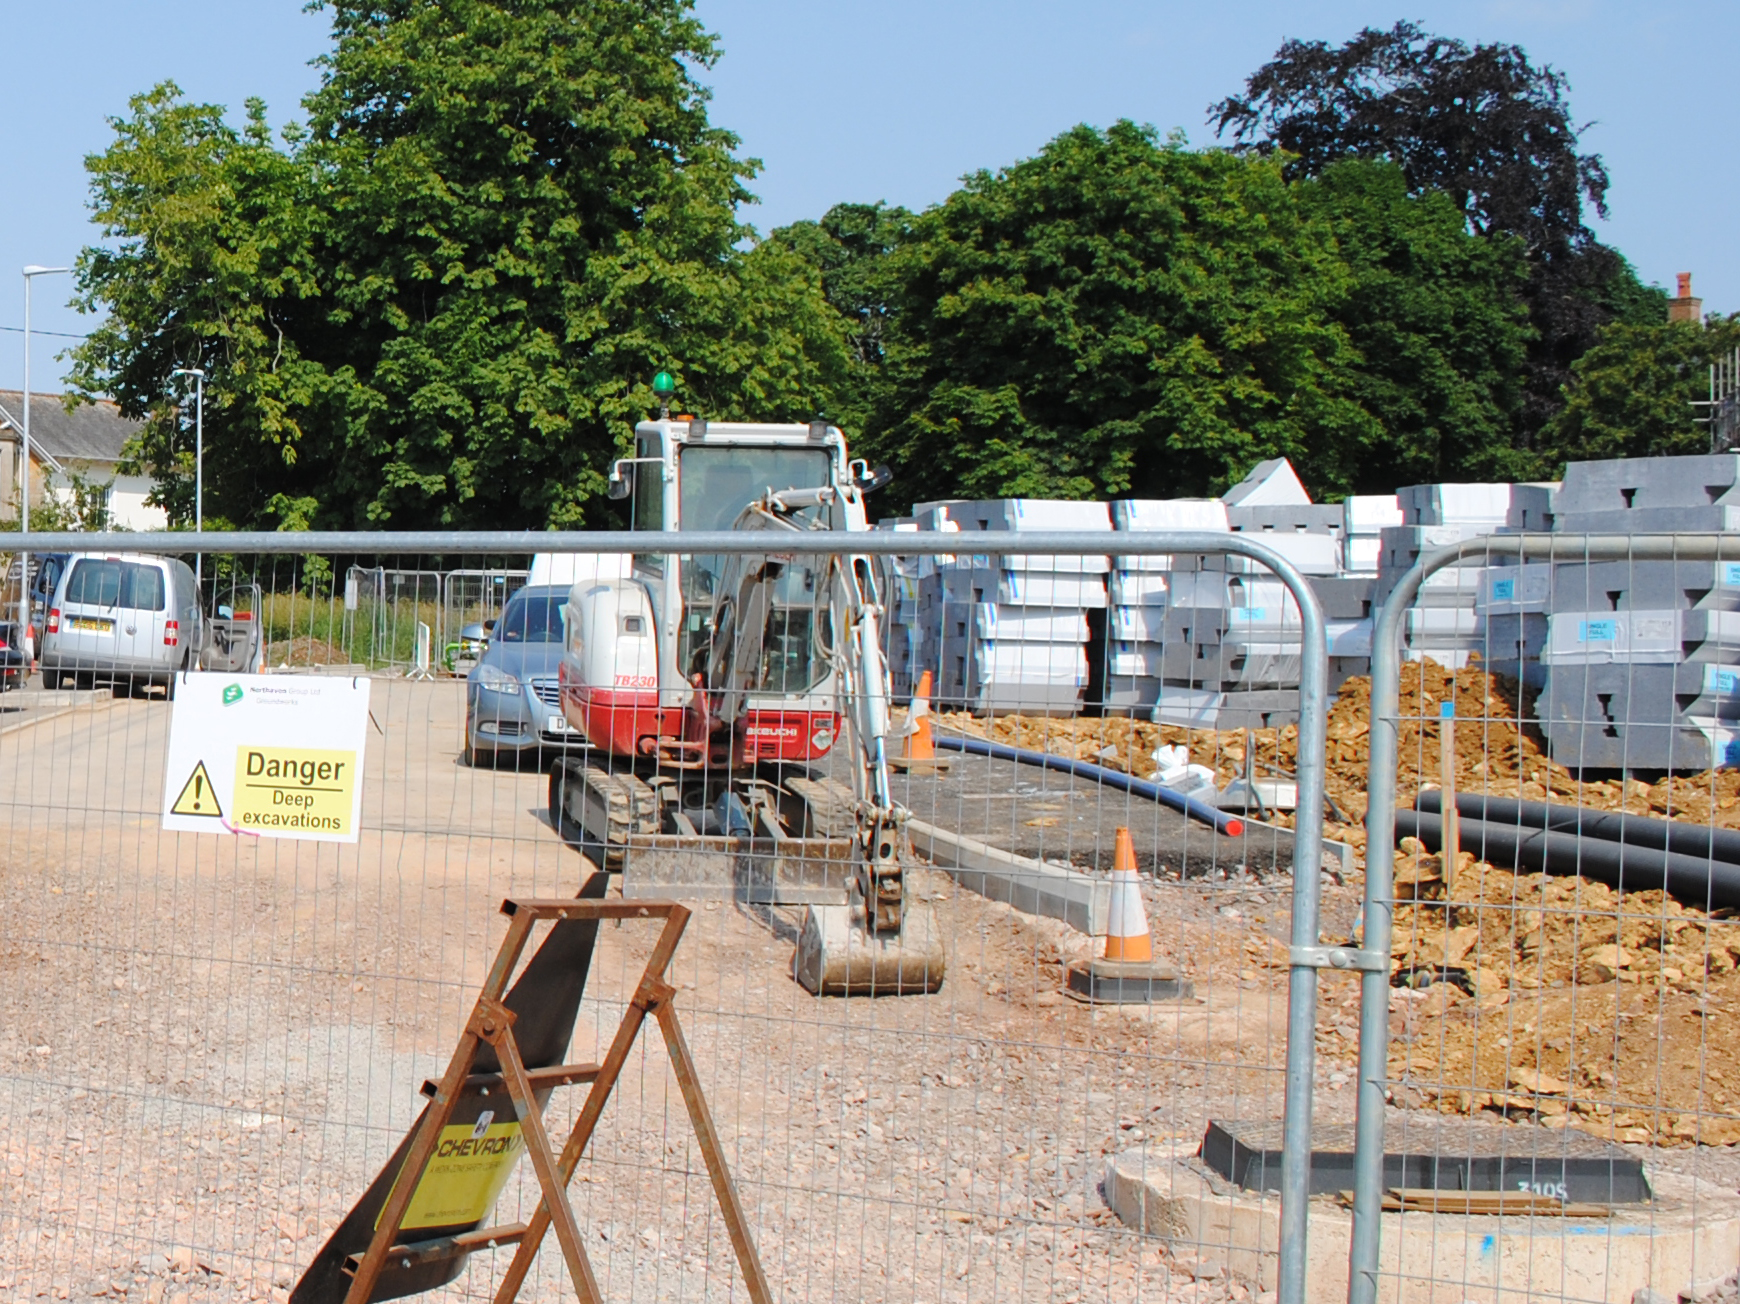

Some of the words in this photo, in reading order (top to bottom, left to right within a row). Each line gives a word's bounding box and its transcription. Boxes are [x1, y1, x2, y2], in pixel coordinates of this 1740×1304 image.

[615, 674, 656, 688] TB230
[746, 727, 798, 736] AKEUCHI
[246, 751, 345, 785] Danger
[272, 789, 314, 810] Deep
[242, 811, 341, 830] excavations
[437, 1133, 522, 1157] CHEVRON
